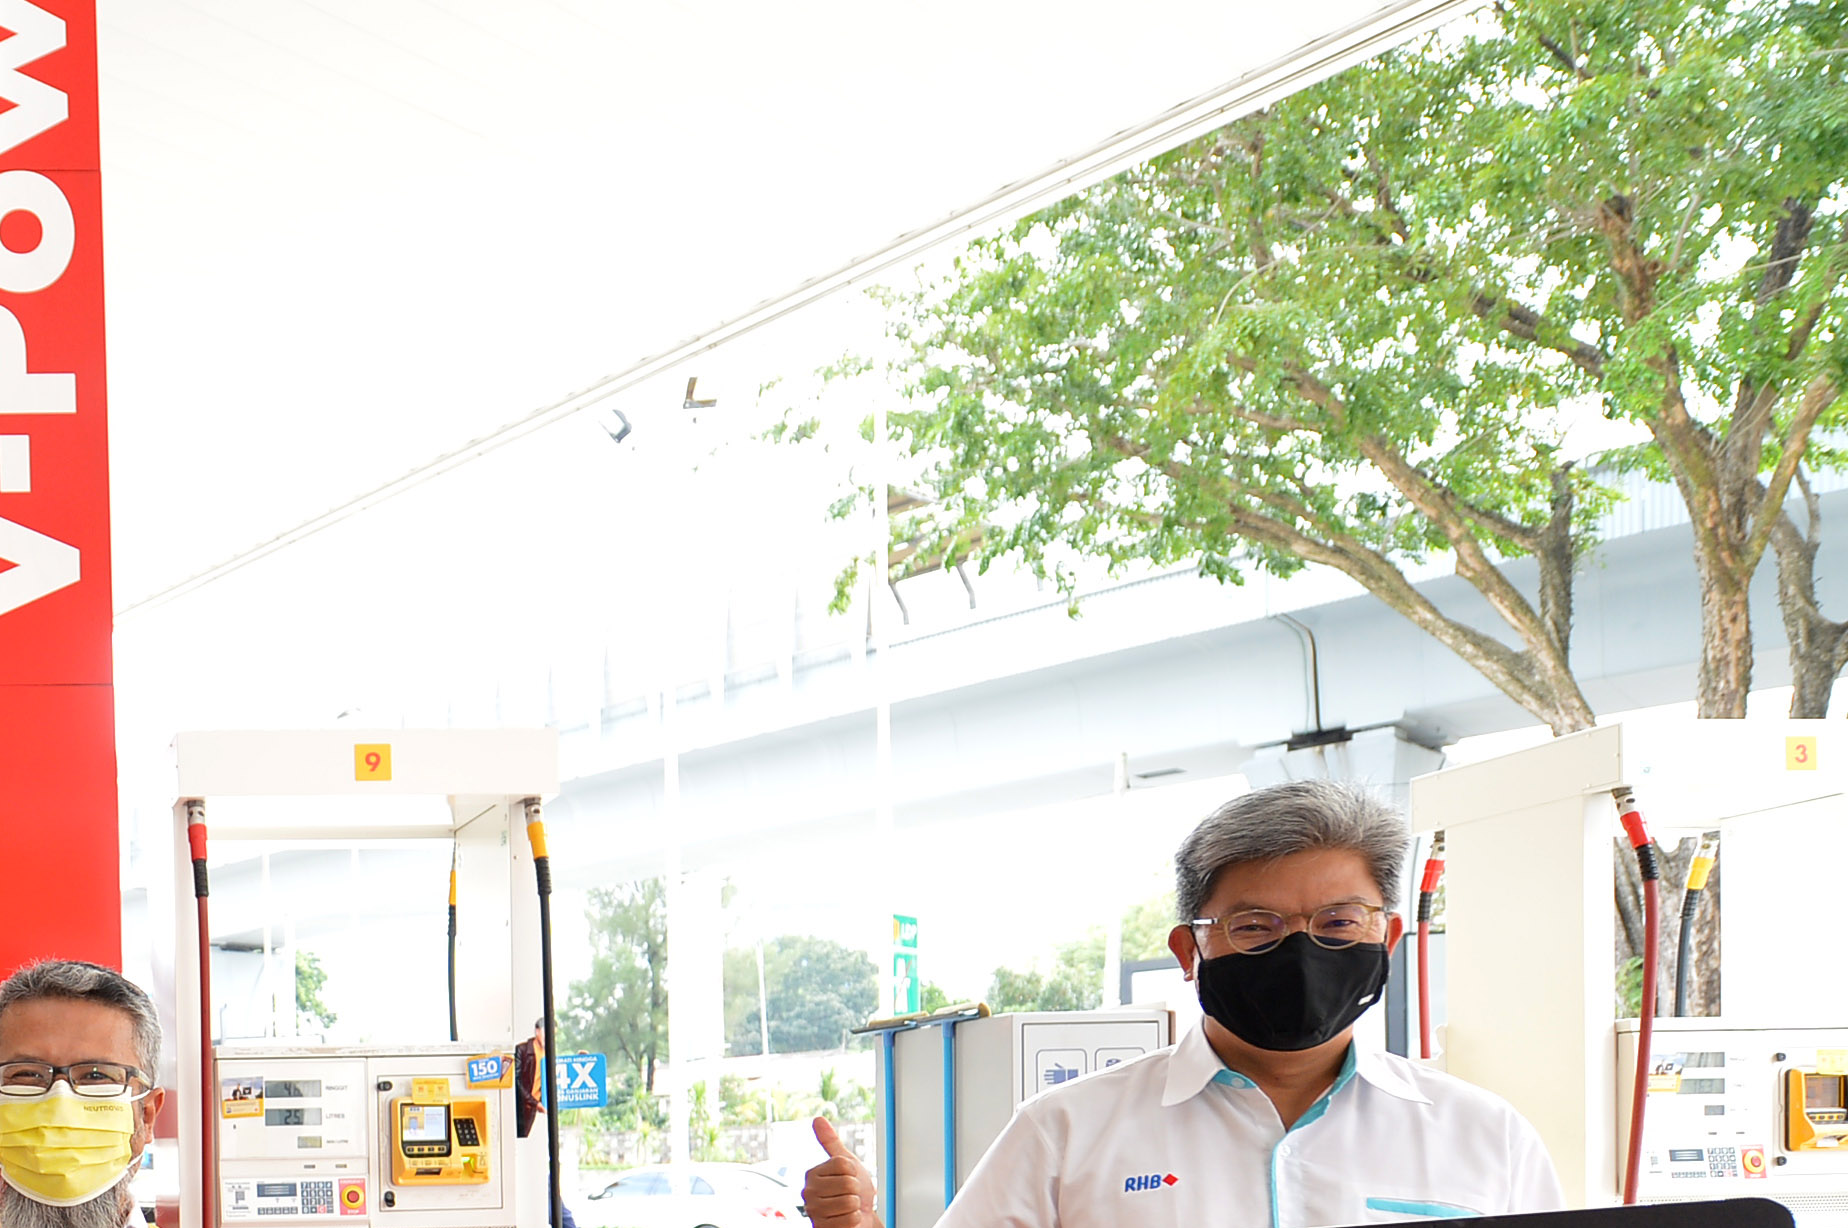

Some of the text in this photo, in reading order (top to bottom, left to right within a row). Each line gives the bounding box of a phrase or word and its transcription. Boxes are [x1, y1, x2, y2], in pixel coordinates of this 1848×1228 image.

[365, 752, 381, 772] 9
[1795, 744, 1808, 763] 3
[471, 1060, 498, 1077] 150
[556, 1062, 598, 1089] 4X
[1124, 1174, 1161, 1192] RHB
